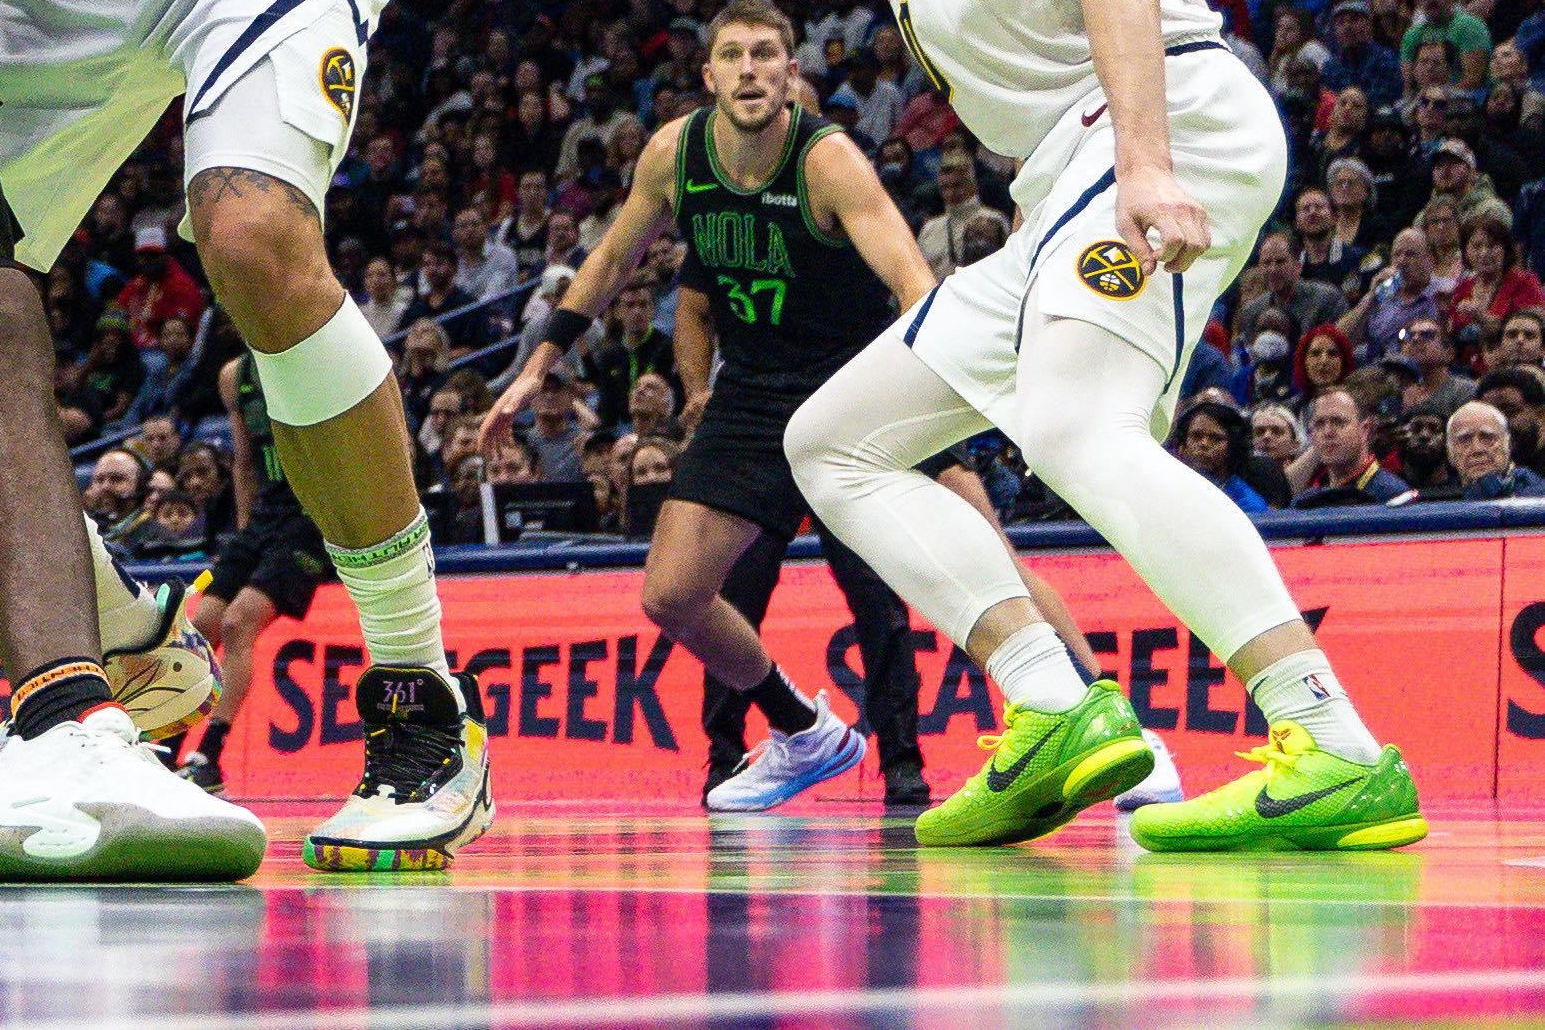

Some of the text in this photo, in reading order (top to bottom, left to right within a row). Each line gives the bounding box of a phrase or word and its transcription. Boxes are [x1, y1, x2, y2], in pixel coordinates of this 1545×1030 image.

[761, 191, 798, 207] ibotta
[692, 210, 797, 279] NOLA
[717, 273, 787, 326] 37
